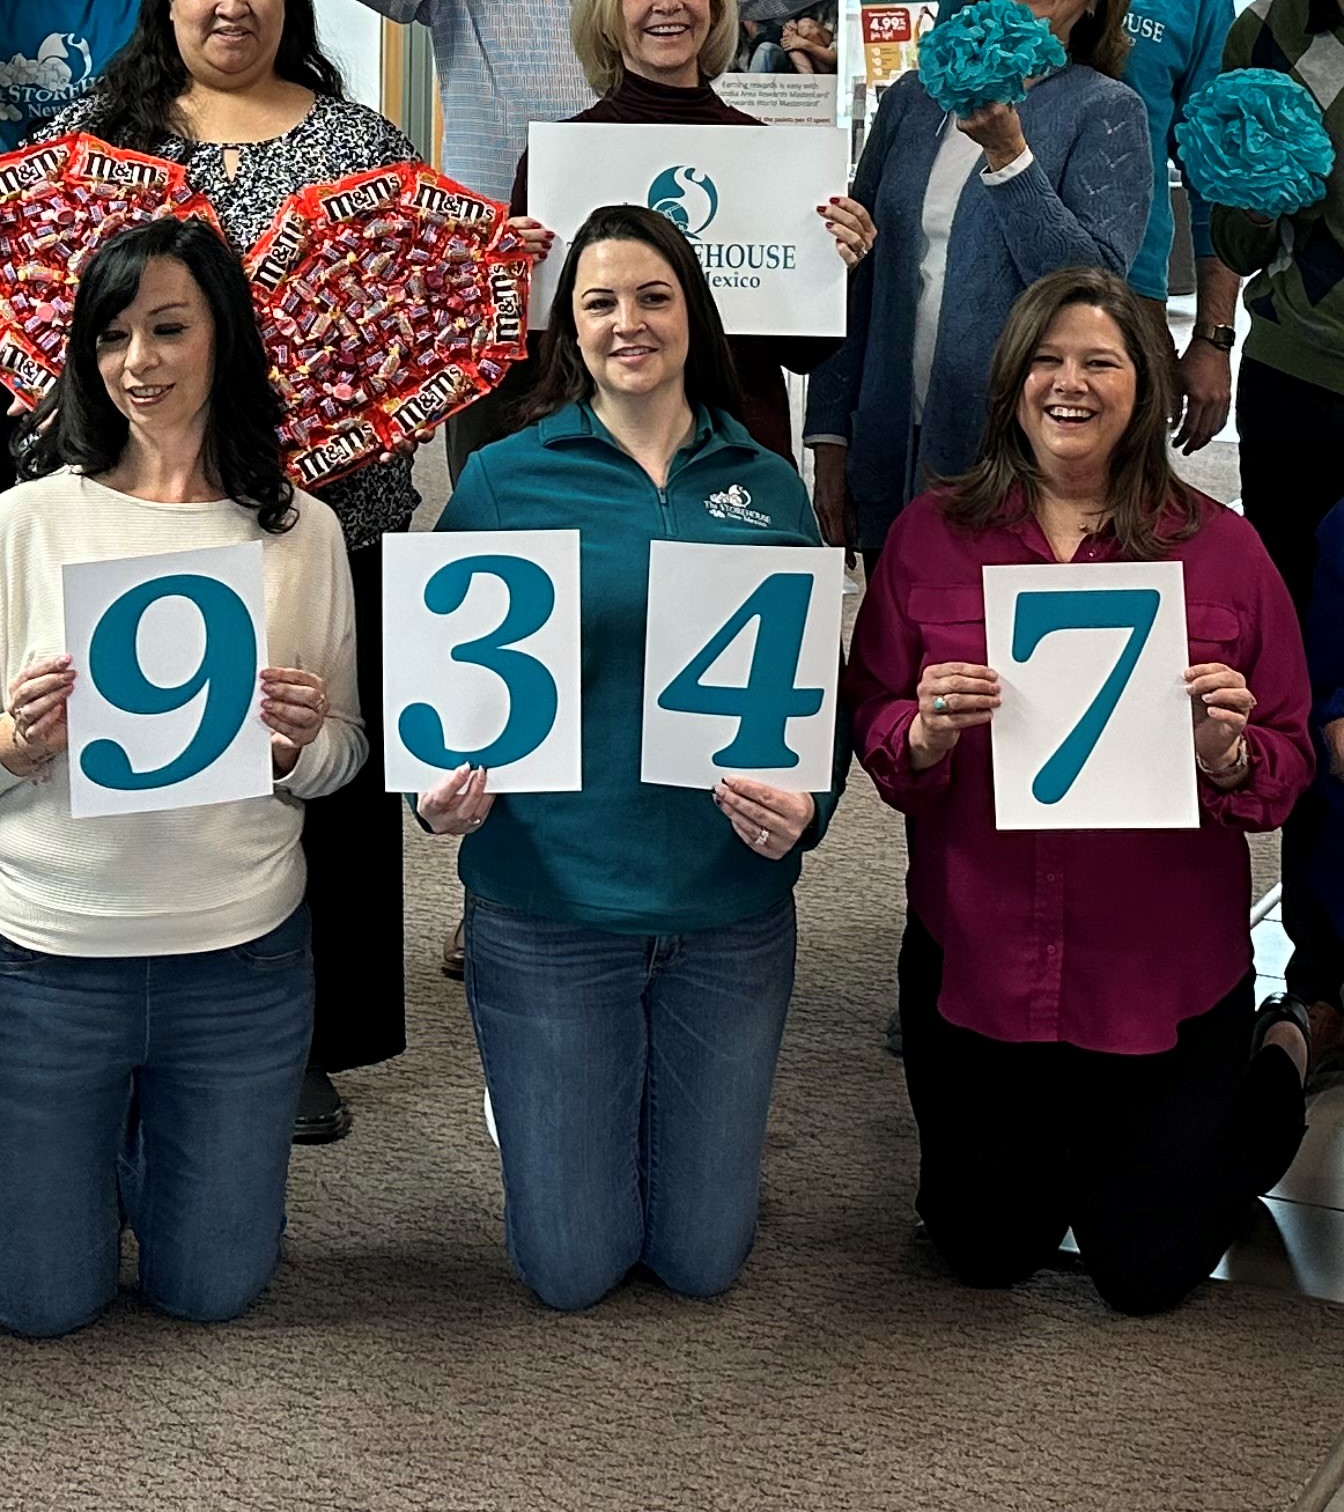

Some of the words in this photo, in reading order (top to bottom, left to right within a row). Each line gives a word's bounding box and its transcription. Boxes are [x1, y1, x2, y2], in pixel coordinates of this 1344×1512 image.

[695, 244, 796, 269] EHOUSE
[80, 574, 257, 791] 9
[398, 554, 558, 770] 3
[657, 573, 824, 769] 4
[1012, 589, 1161, 804] 7
